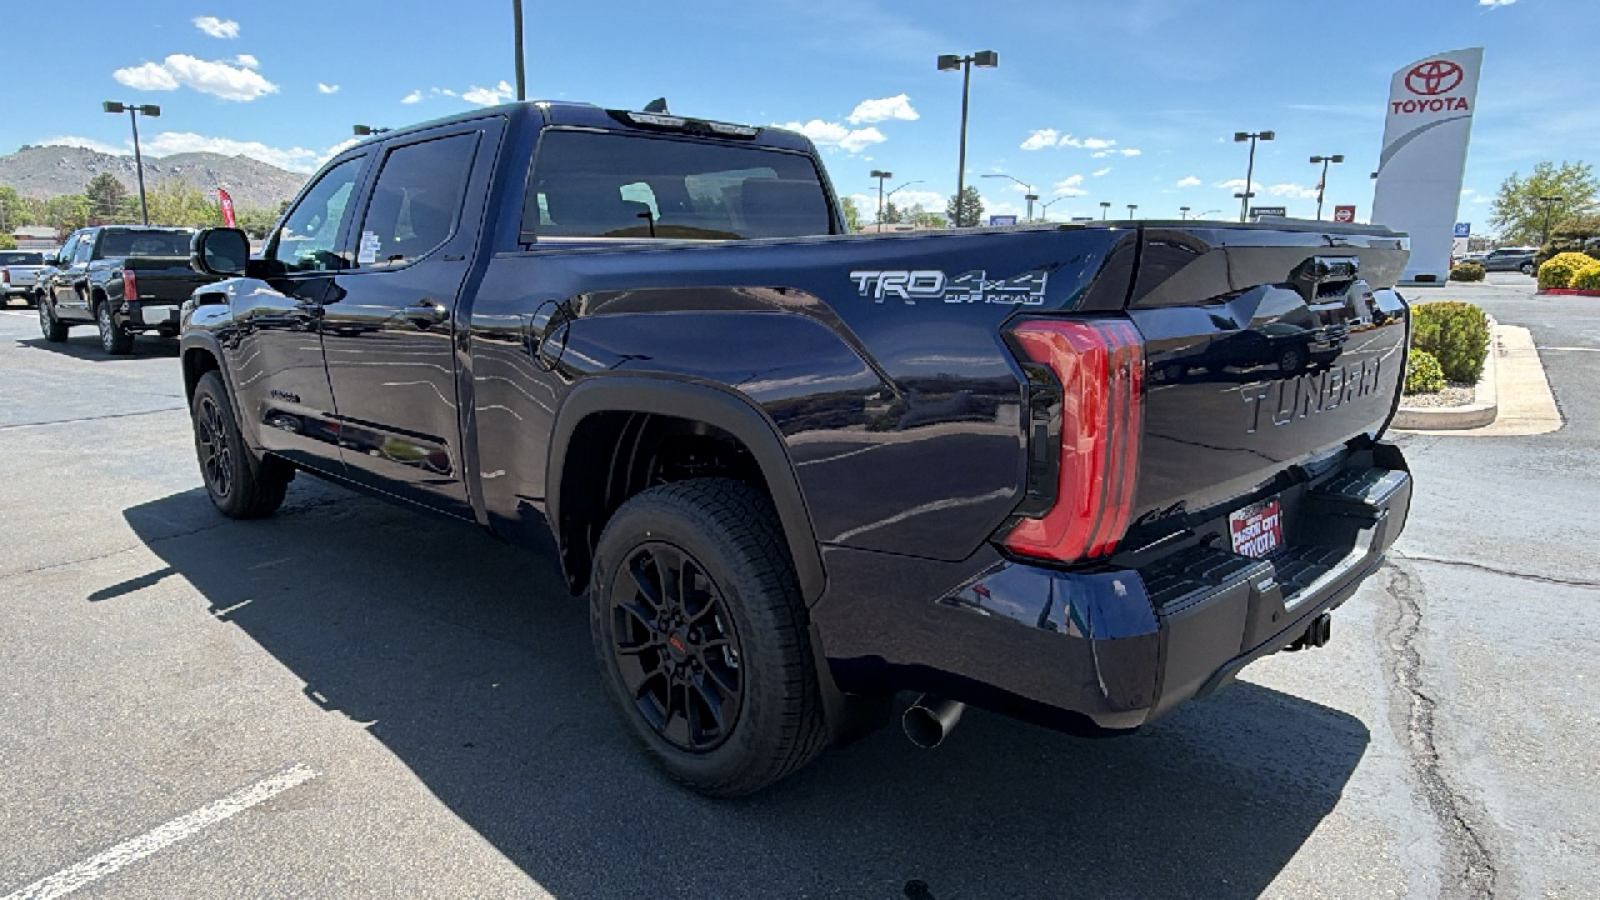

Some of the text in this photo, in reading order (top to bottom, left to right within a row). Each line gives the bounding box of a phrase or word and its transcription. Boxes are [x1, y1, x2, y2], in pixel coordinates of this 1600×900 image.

[1392, 97, 1469, 115] TOYOTA
[850, 270, 946, 305] TRD
[944, 294, 1044, 305] OFF ROAD
[1240, 357, 1382, 434] TUNDRA
[1234, 522, 1261, 546] CARSON
[1262, 514, 1279, 531] CITY
[1239, 530, 1276, 558] TOYOTA
